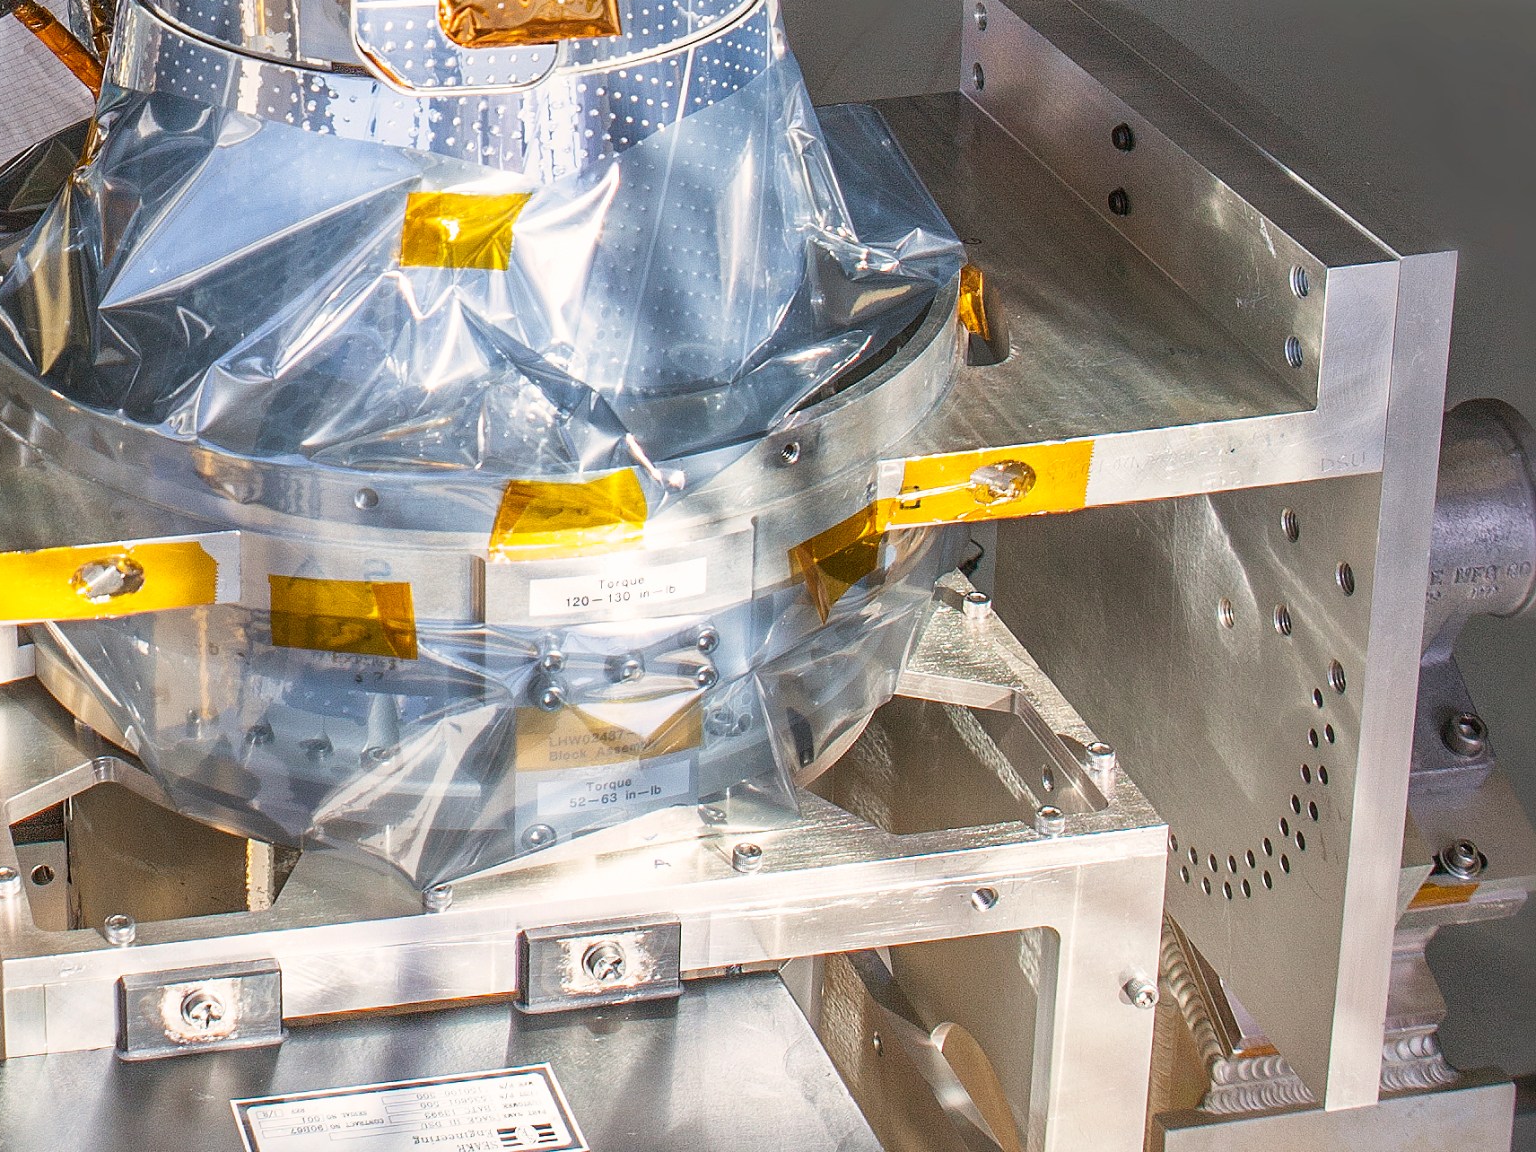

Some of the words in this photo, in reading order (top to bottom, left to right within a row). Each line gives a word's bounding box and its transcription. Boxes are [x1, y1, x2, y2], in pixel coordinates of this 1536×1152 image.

[599, 577, 645, 590] Torque
[549, 750, 586, 762] Block
[586, 778, 633, 792] Torque
[569, 792, 618, 808] 52-63
[412, 1129, 493, 1146] Engineering
